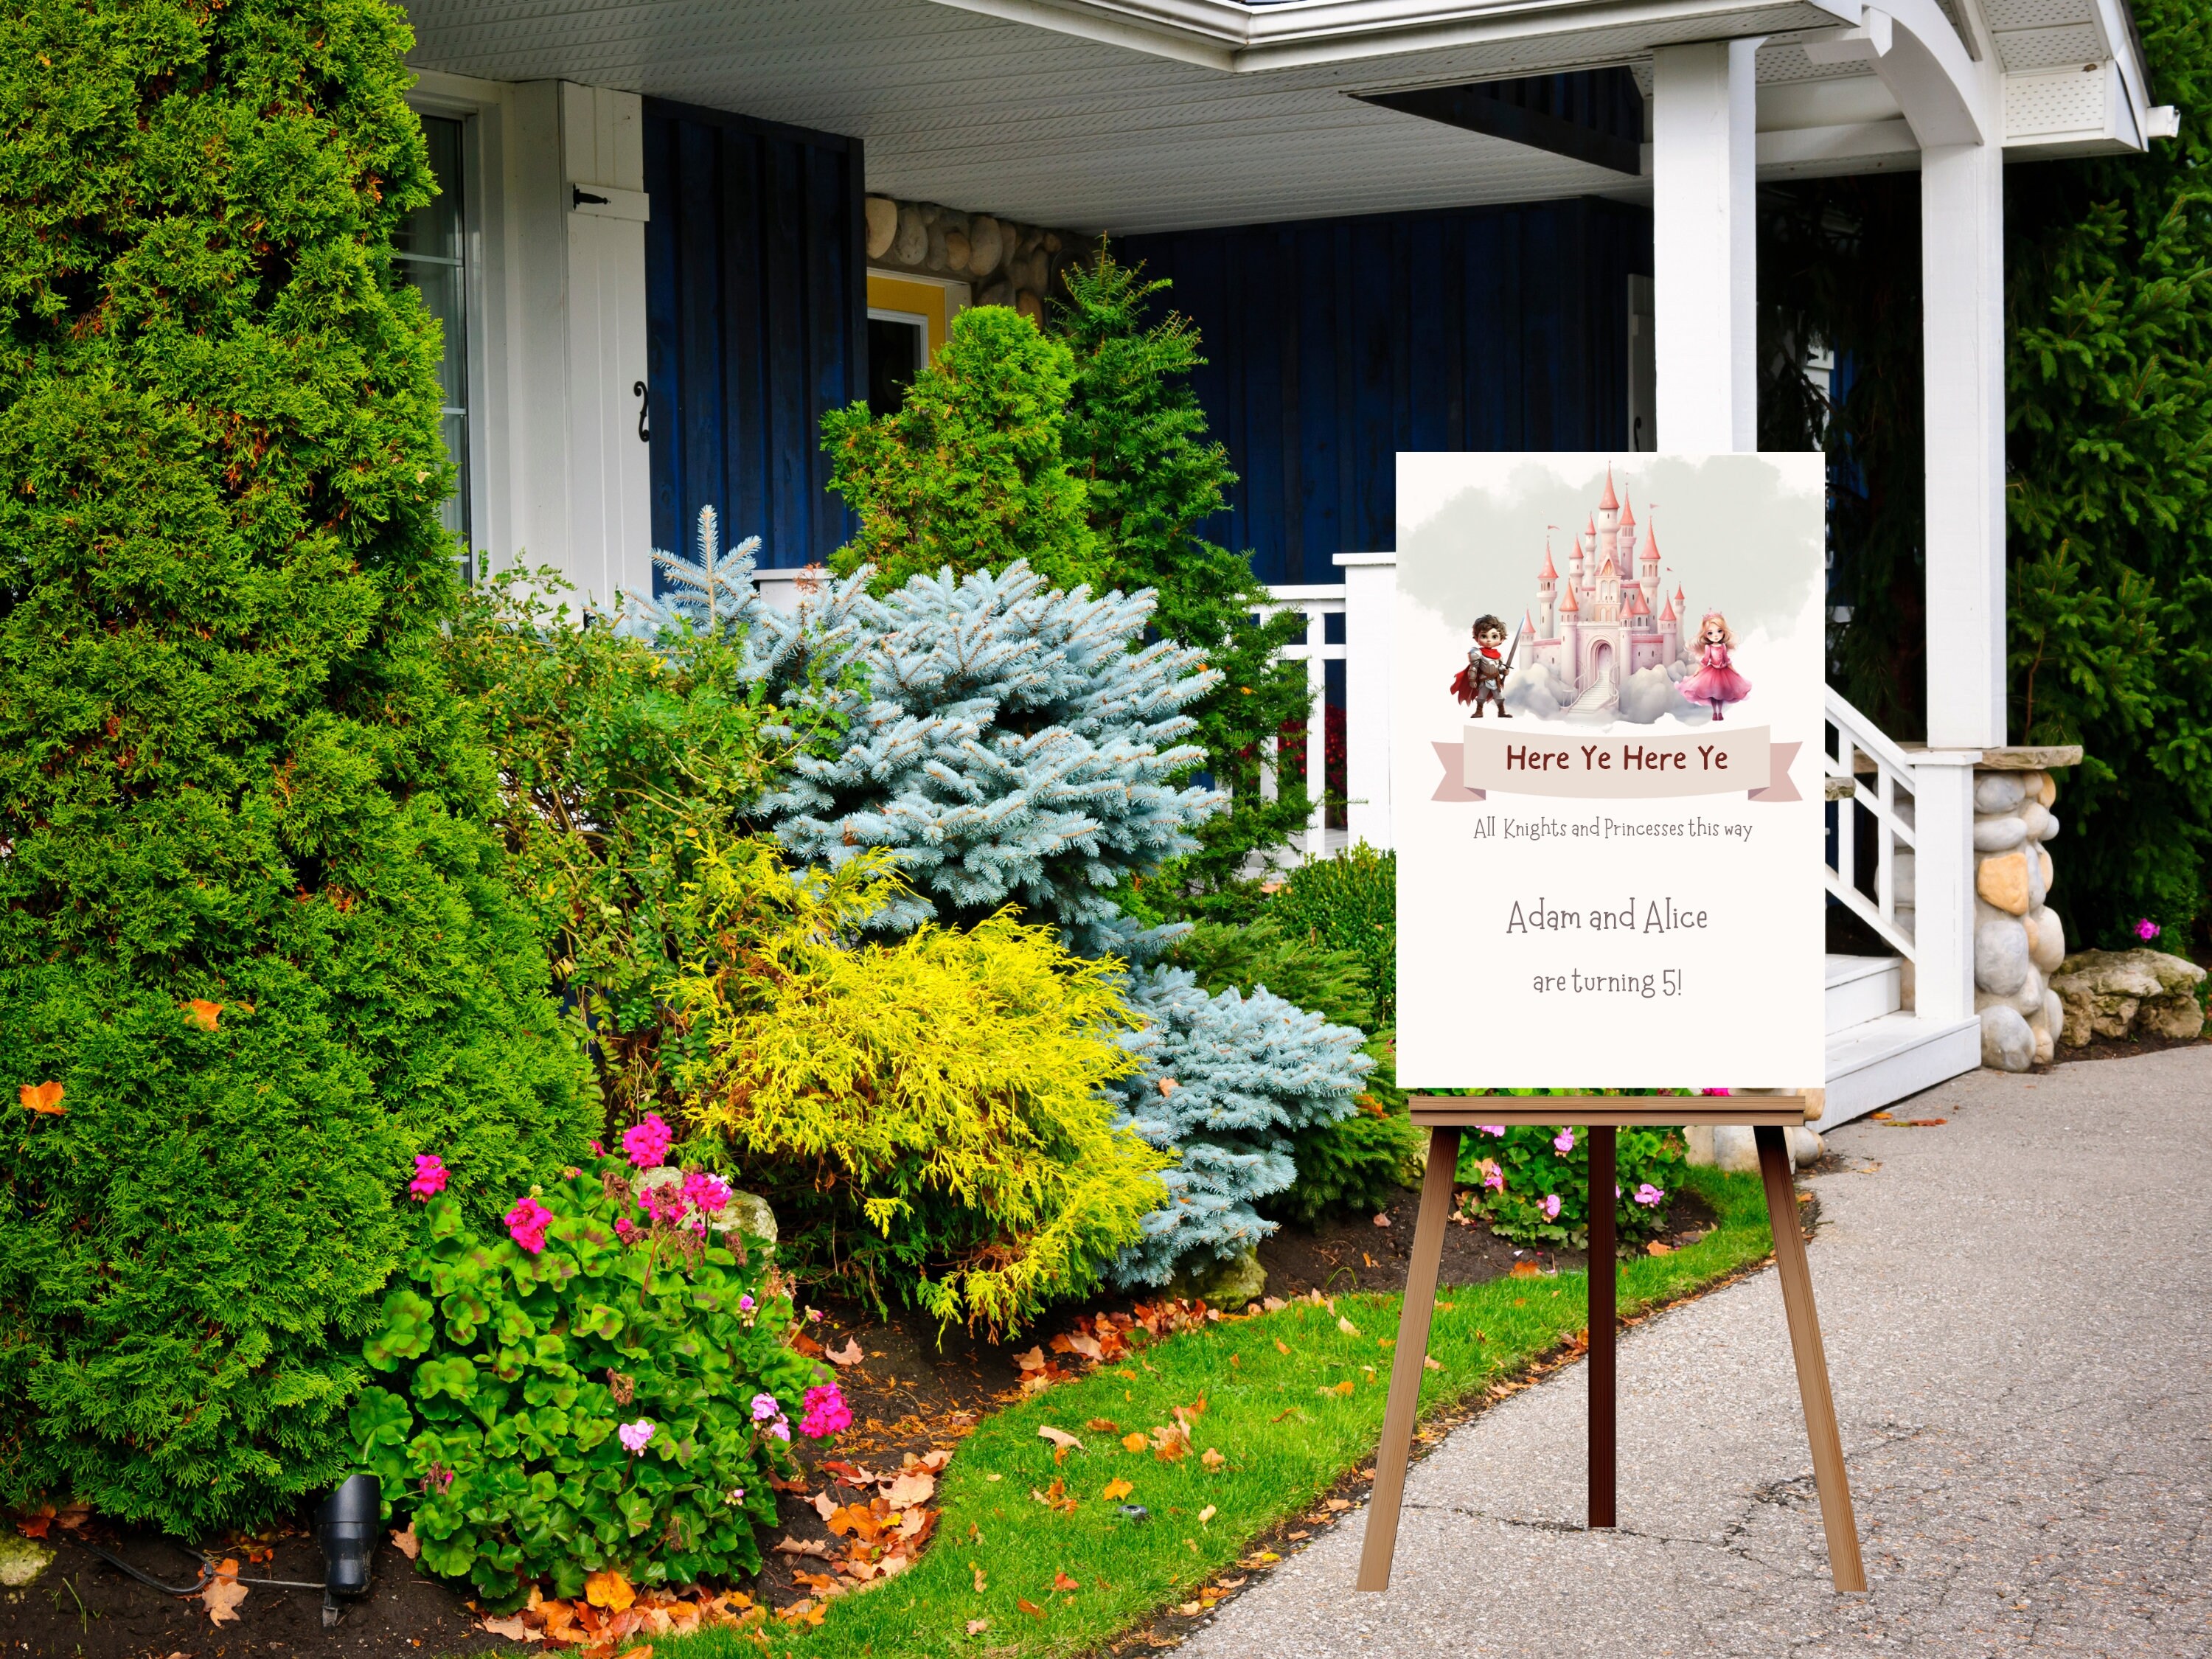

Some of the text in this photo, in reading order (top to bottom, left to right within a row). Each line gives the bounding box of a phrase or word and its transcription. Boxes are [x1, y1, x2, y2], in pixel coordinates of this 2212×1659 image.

[1507, 745, 1728, 771] Here Ye Here Ye
[1473, 815, 1753, 842] All Knights and Princesses this way
[1506, 897, 1708, 934] Adam and Alice
[1533, 967, 1682, 999] are turning 5!
